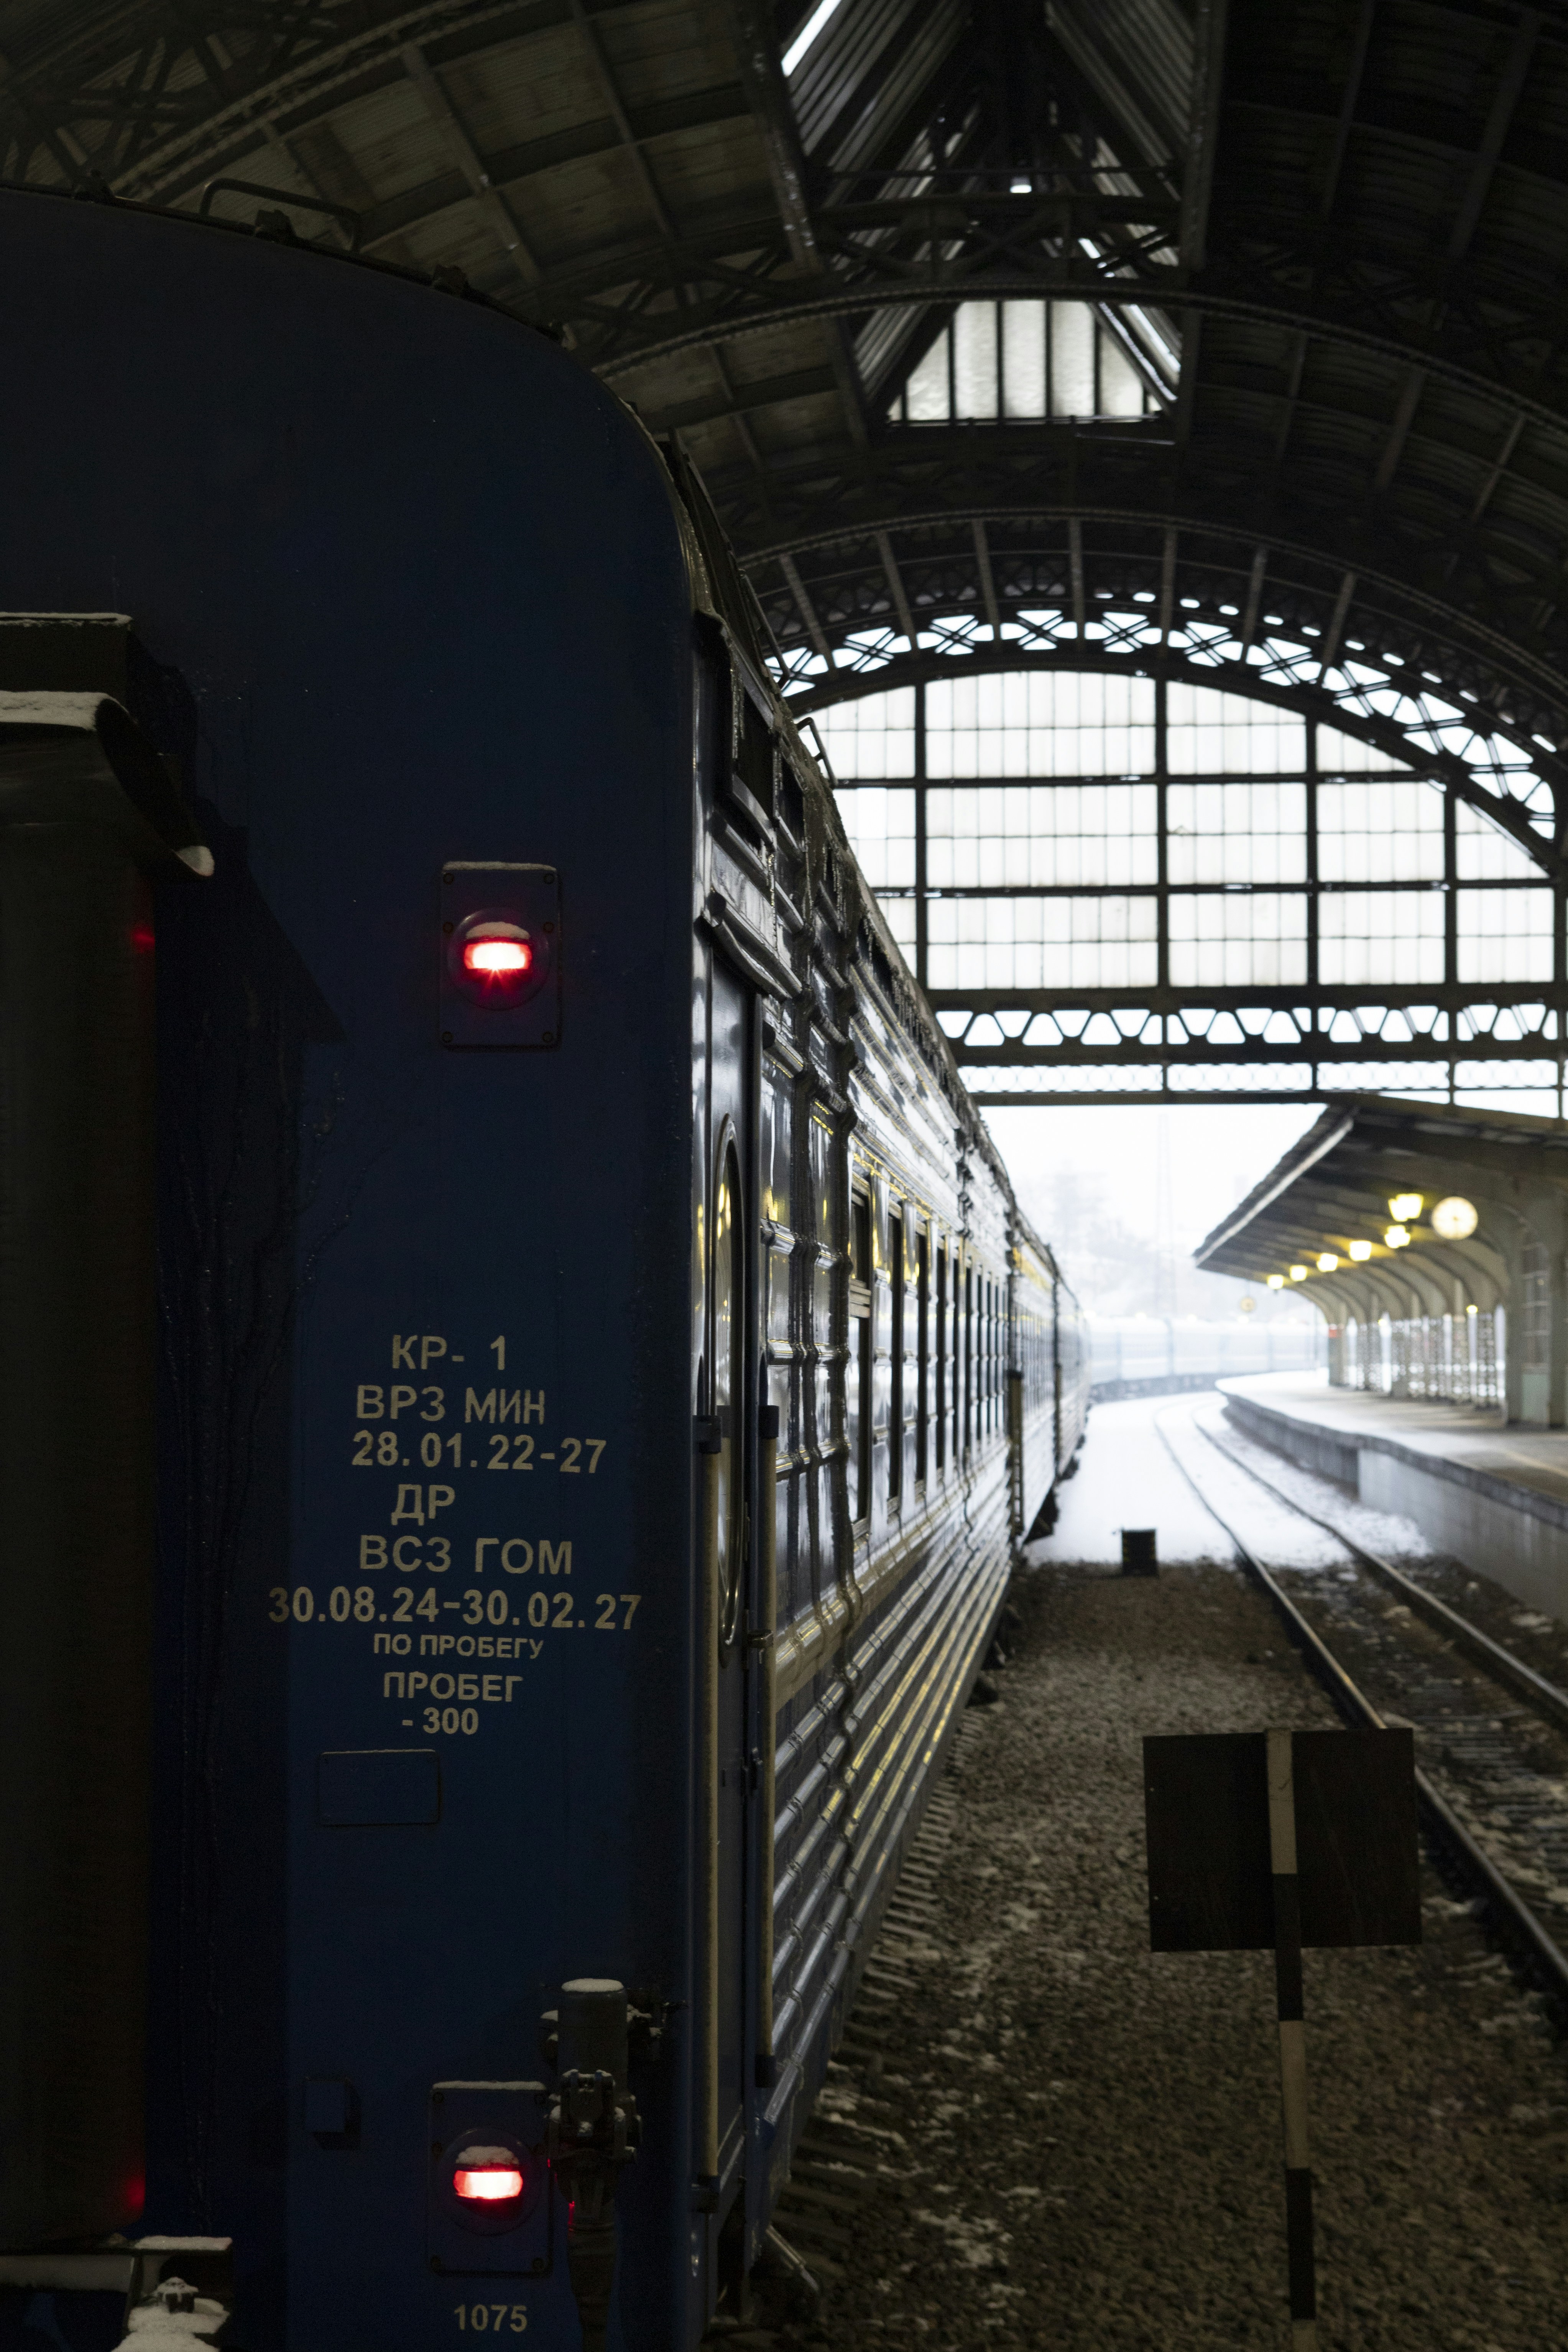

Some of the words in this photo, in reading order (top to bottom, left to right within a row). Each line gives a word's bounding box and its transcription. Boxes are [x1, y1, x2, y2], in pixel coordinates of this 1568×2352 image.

[357, 1385, 445, 1422] ВРЗ
[465, 1387, 544, 1424] МИН
[352, 1430, 606, 1473] 28.01.22-27
[391, 1484, 455, 1526] ДР
[360, 1535, 451, 1572] ВСЗ
[475, 1538, 572, 1575] ГОМ
[269, 1586, 641, 1630] 30.08.24-30.02.27
[374, 1634, 411, 1655] ПО
[384, 1671, 523, 1702] ПРОБЕГ
[454, 2304, 528, 2332] 1075
